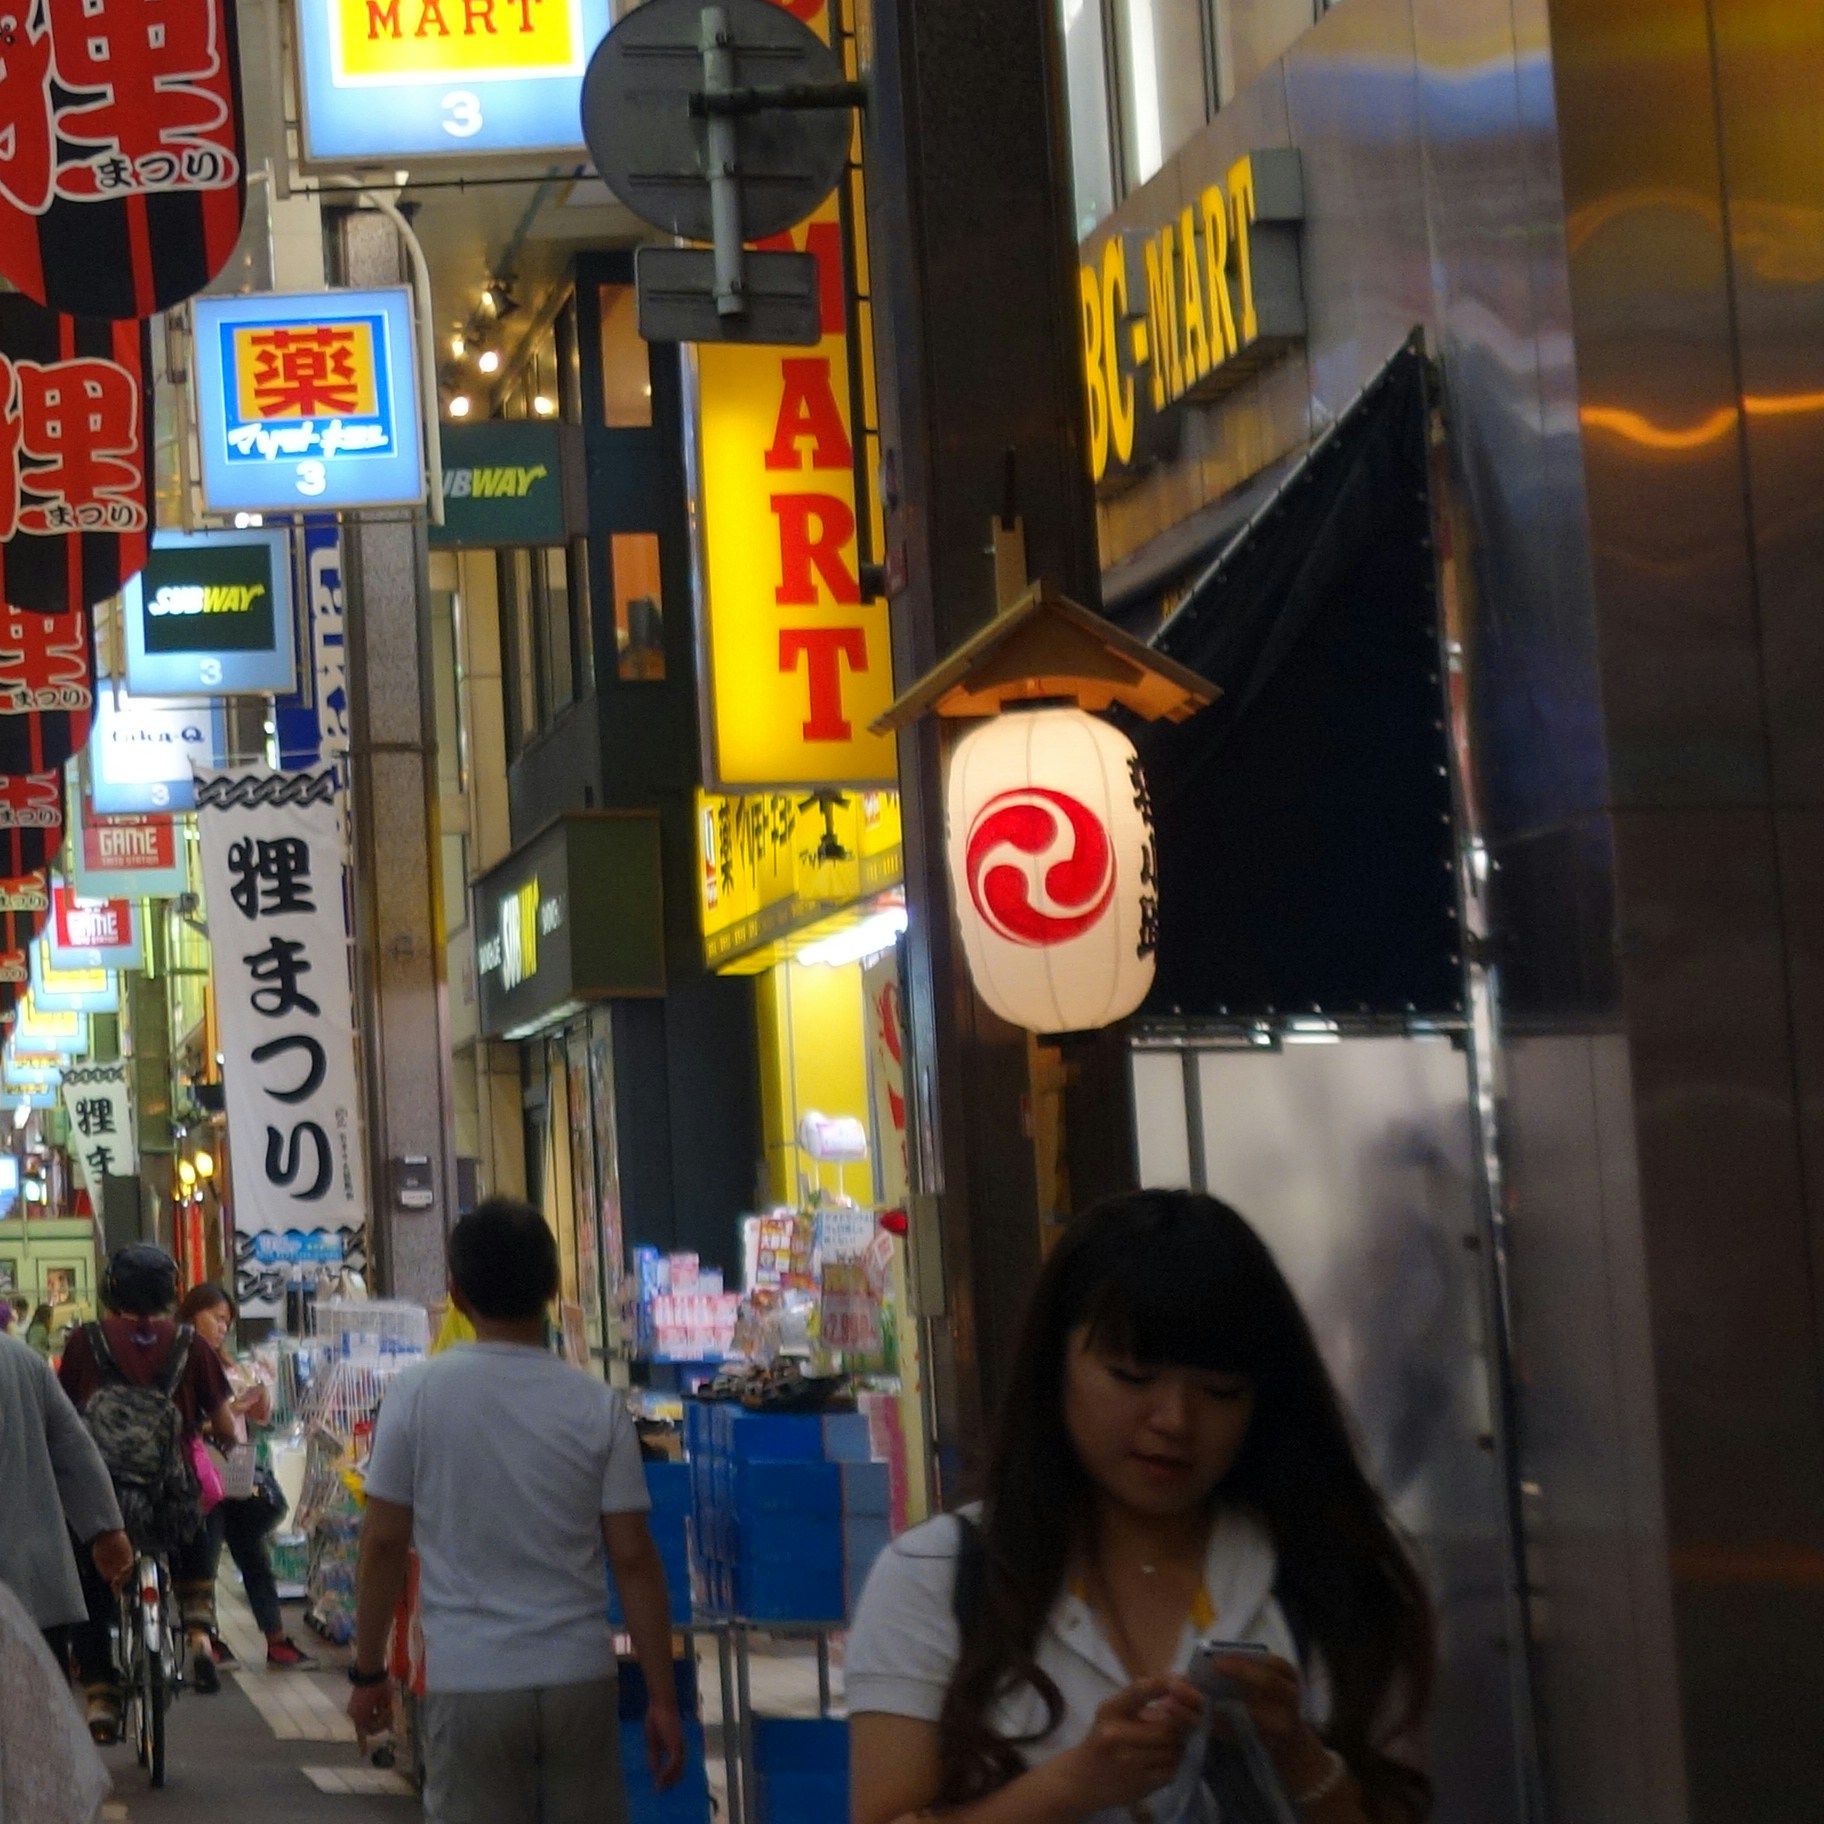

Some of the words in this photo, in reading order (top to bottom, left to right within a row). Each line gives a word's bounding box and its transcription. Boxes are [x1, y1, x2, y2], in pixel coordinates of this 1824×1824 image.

[441, 89, 484, 139] 3
[94, 148, 220, 191] まつり
[250, 328, 359, 418] 薬
[295, 460, 327, 496] 3
[427, 462, 547, 499] UBWAY
[47, 502, 137, 531] まつり
[148, 582, 266, 617] SUBWAY
[199, 657, 223, 687] 3
[151, 783, 171, 805] 3
[99, 828, 158, 856] GAME
[229, 837, 334, 1203] 狸まつり
